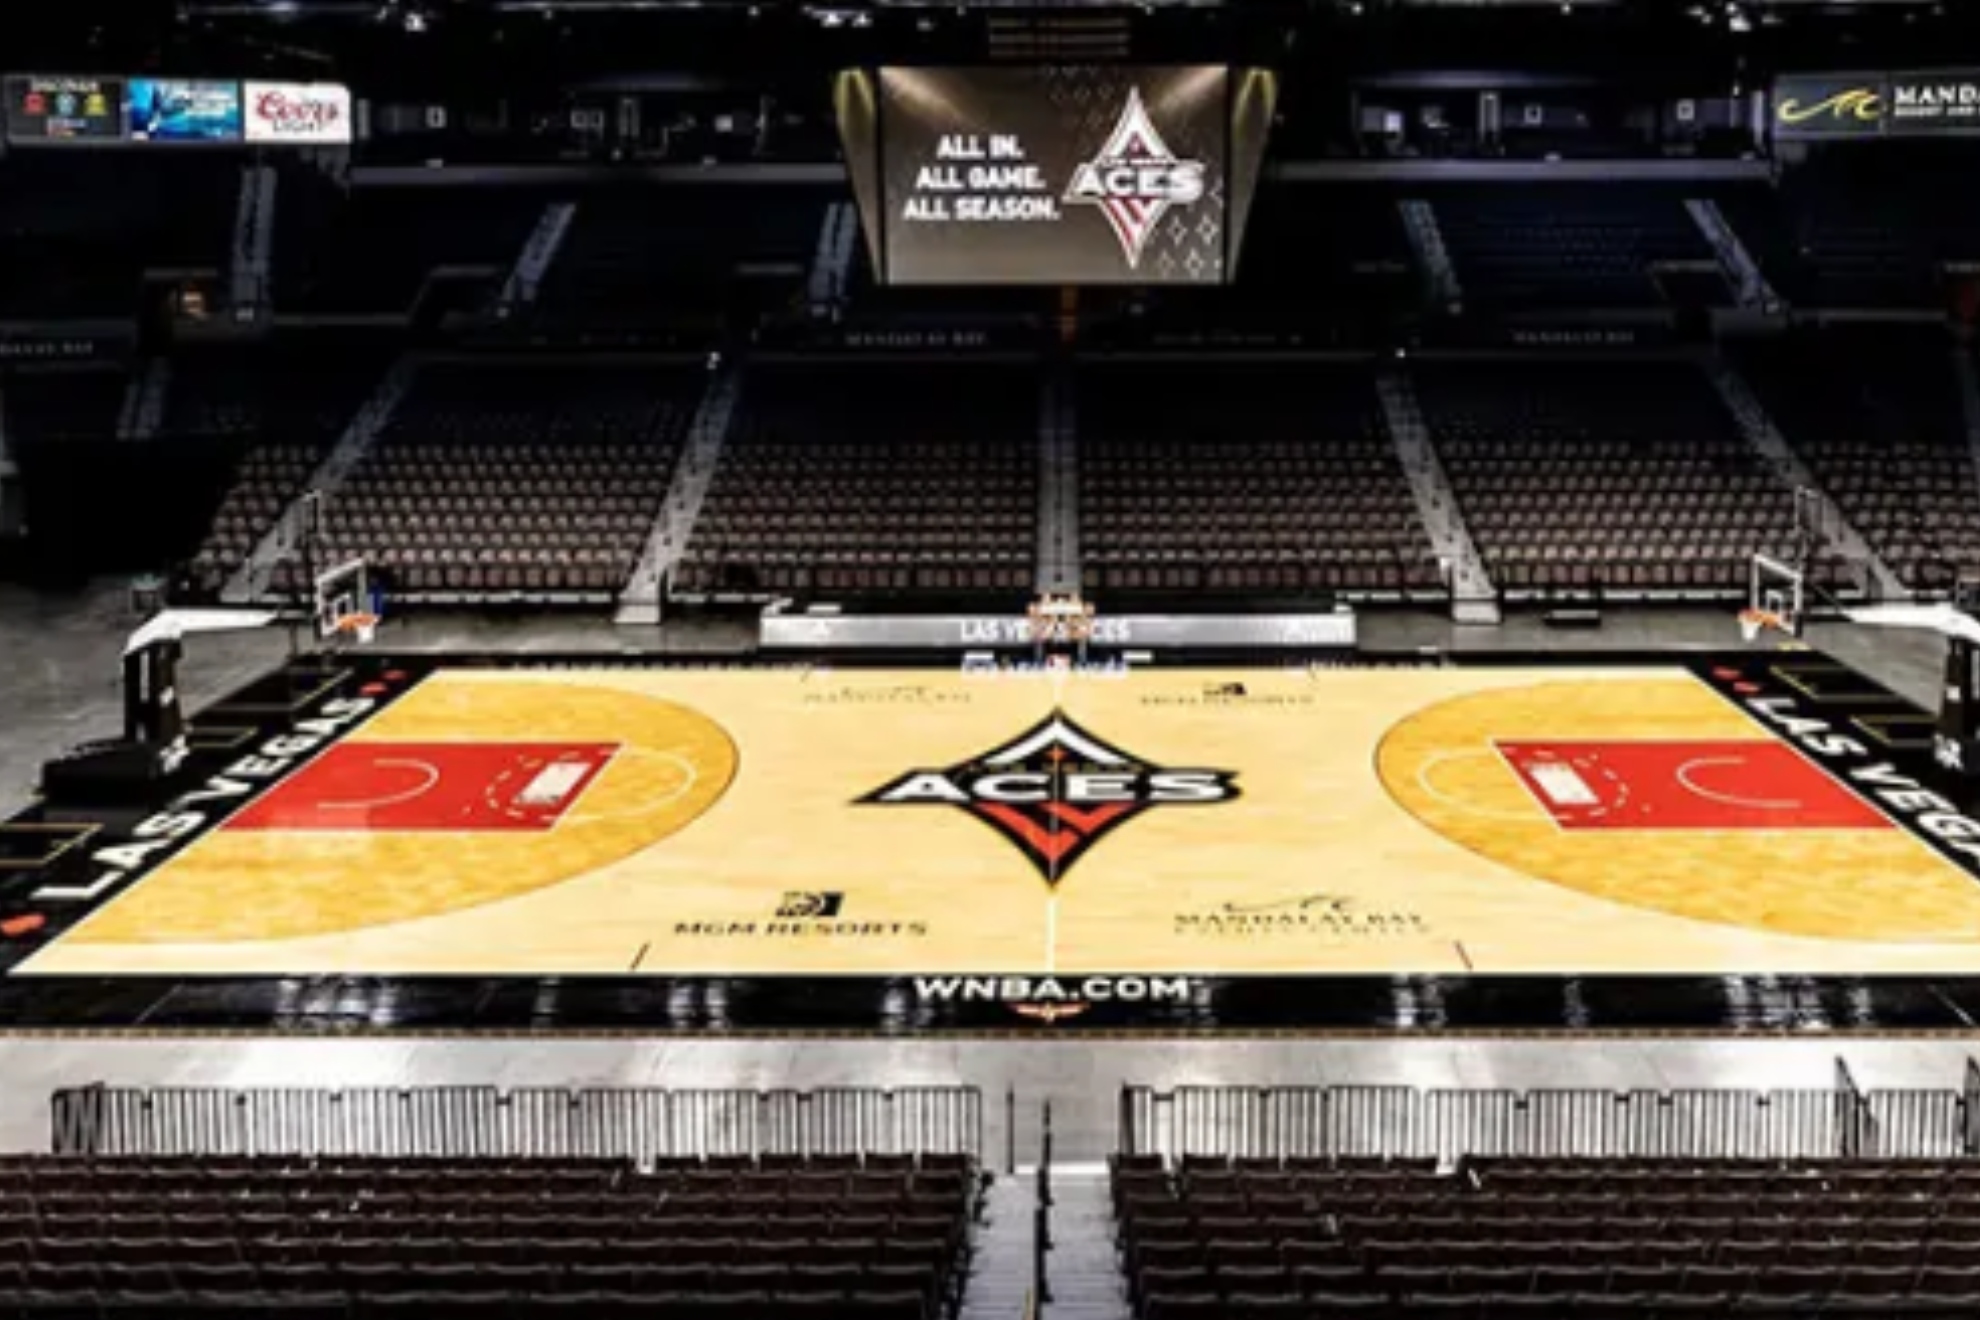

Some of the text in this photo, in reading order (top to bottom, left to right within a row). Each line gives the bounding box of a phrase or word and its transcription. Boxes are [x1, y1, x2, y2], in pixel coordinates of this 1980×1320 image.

[256, 91, 339, 121] Coors
[1894, 82, 1980, 105] MAND
[937, 135, 1024, 158] ALL IN.
[916, 167, 1046, 189] ALL GAME.
[1072, 163, 1204, 202] ACES
[903, 199, 1060, 221] ALL SEASON.
[1746, 698, 1869, 756] LAS
[30, 697, 375, 899] LAS VEGAS
[876, 772, 1230, 802] ACES
[913, 976, 1189, 1000] WNBA.COM
